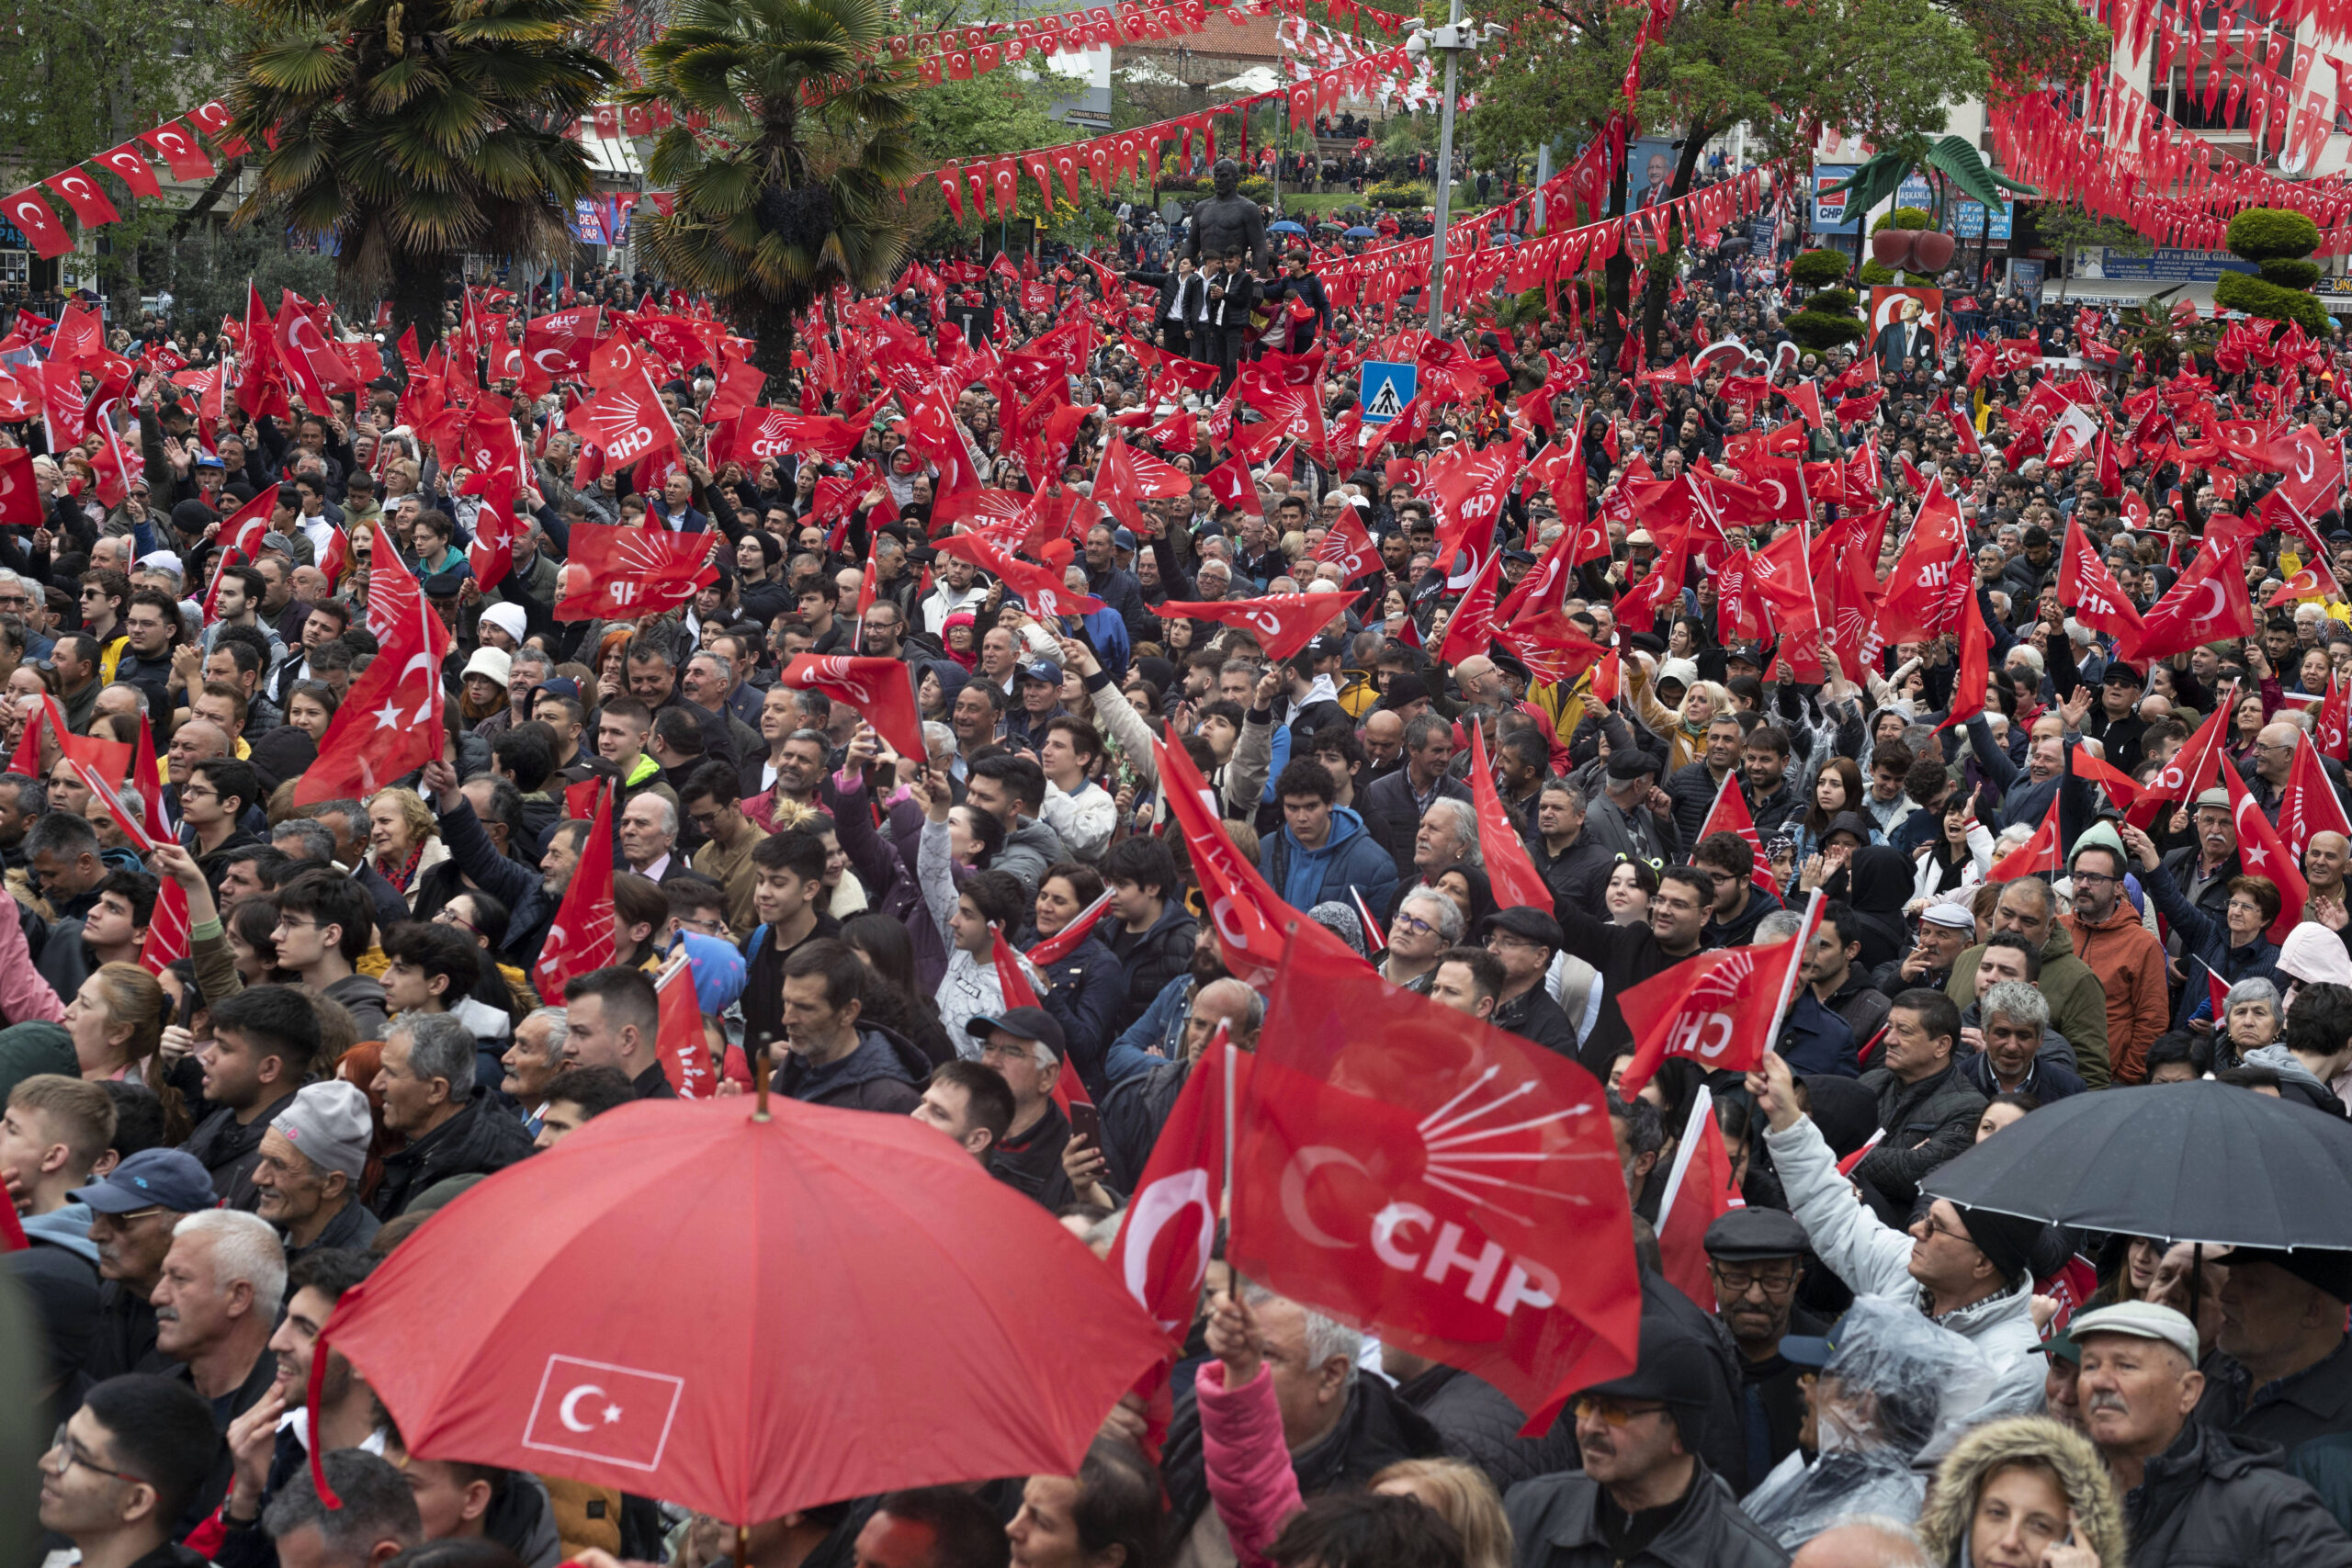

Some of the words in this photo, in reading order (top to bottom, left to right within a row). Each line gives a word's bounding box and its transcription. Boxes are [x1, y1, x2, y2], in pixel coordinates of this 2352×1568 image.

[1072, 109, 1091, 118] SMANLI
[1092, 111, 1111, 120] PERDE
[1820, 208, 1843, 219] CHP
[582, 228, 597, 240] VAR
[2183, 253, 2211, 262] BALIK
[2212, 254, 2245, 263] GALER
[1028, 295, 1046, 303] CHP
[546, 315, 580, 330] CHP
[1370, 1201, 1561, 1317] CHP
